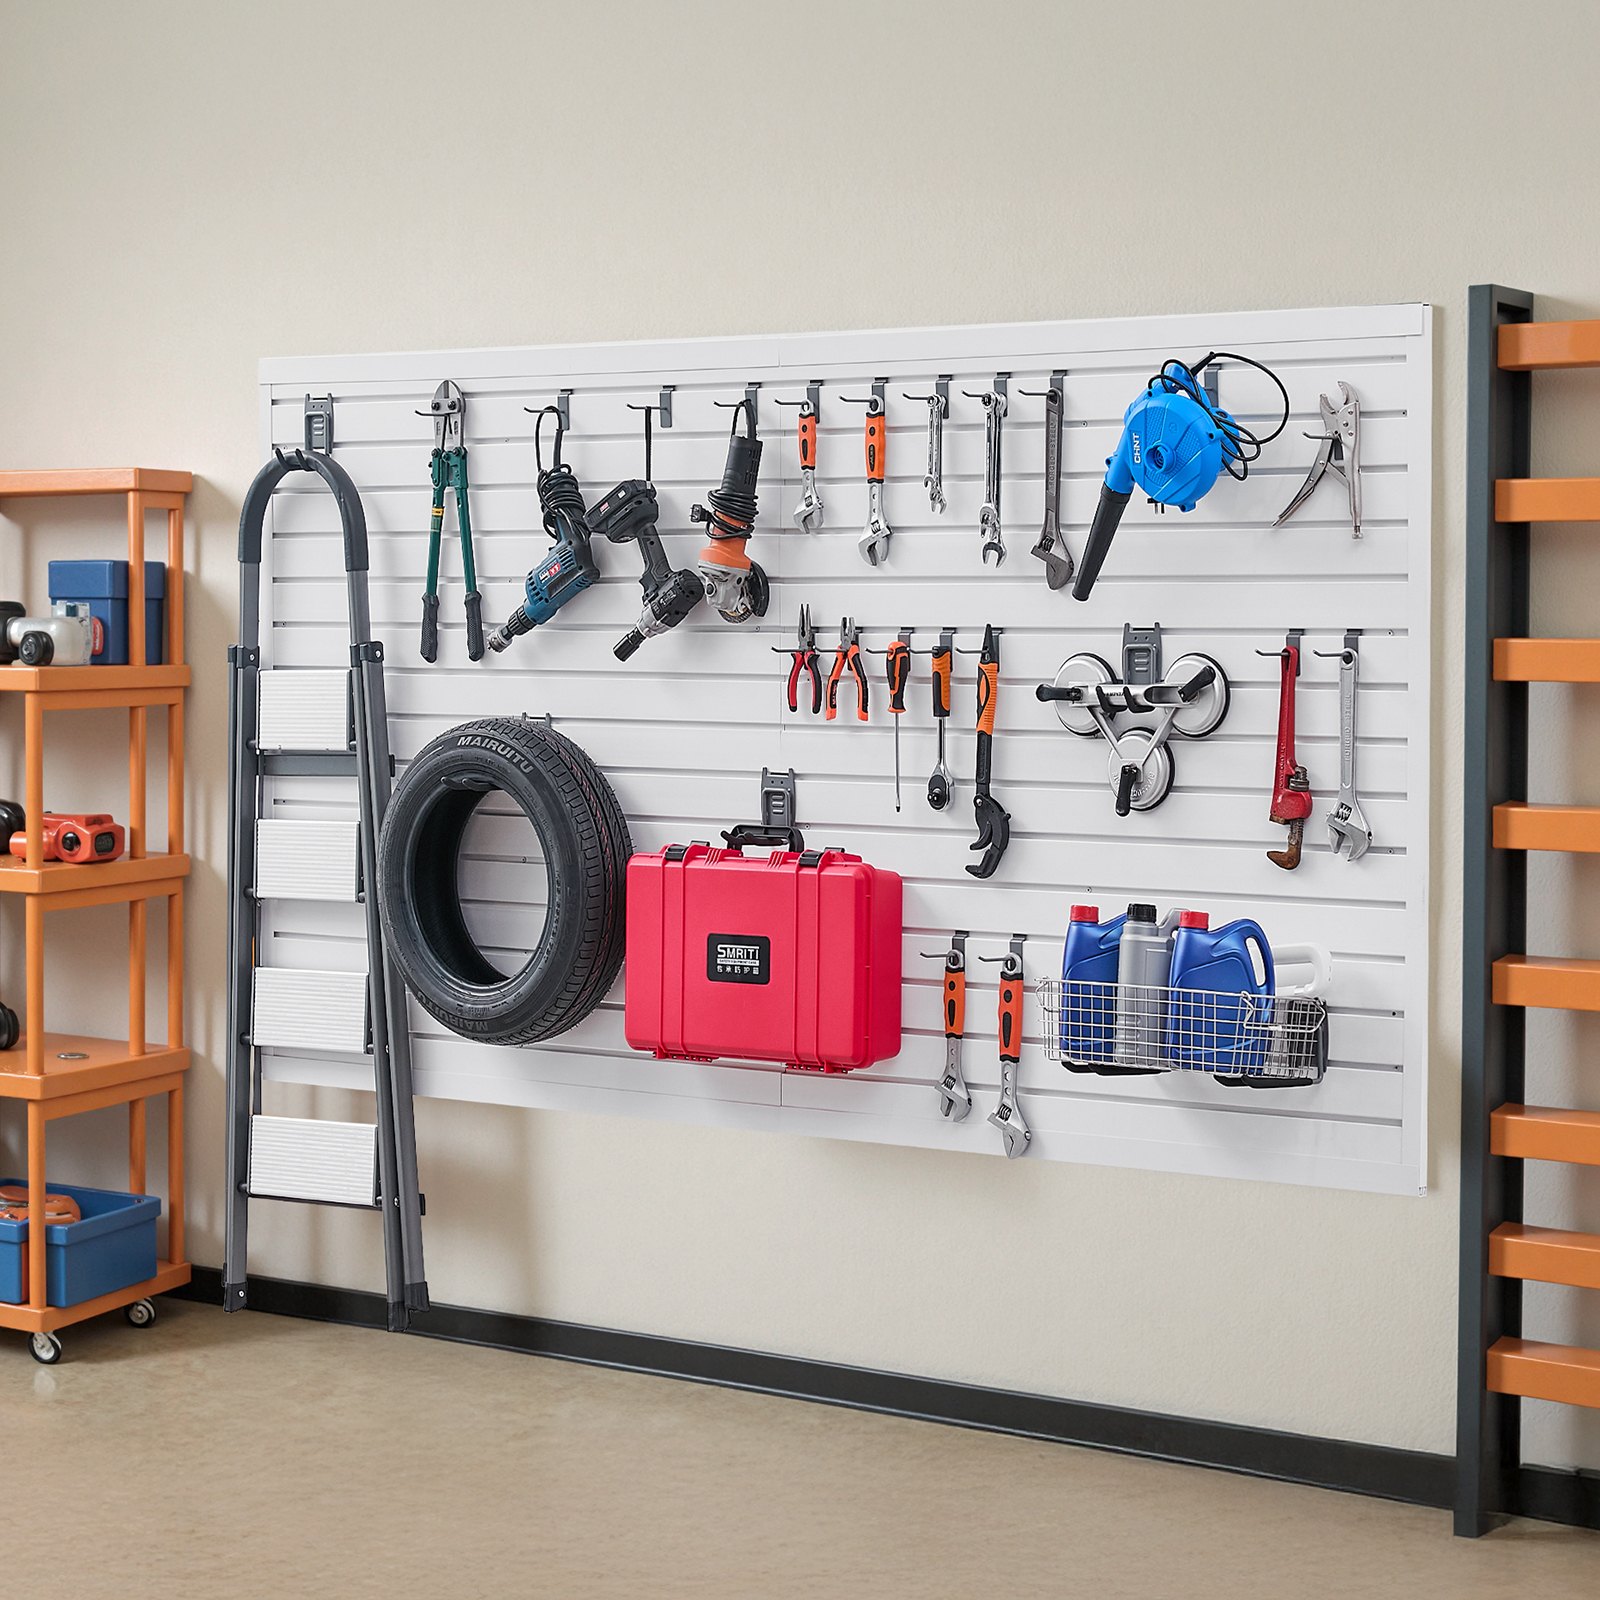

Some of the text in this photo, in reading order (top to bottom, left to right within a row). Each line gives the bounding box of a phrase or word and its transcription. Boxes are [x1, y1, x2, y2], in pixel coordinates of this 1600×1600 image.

[1132, 433, 1141, 464] CHNT
[457, 736, 534, 774] MAIRUITU
[717, 944, 760, 959] SMRITI
